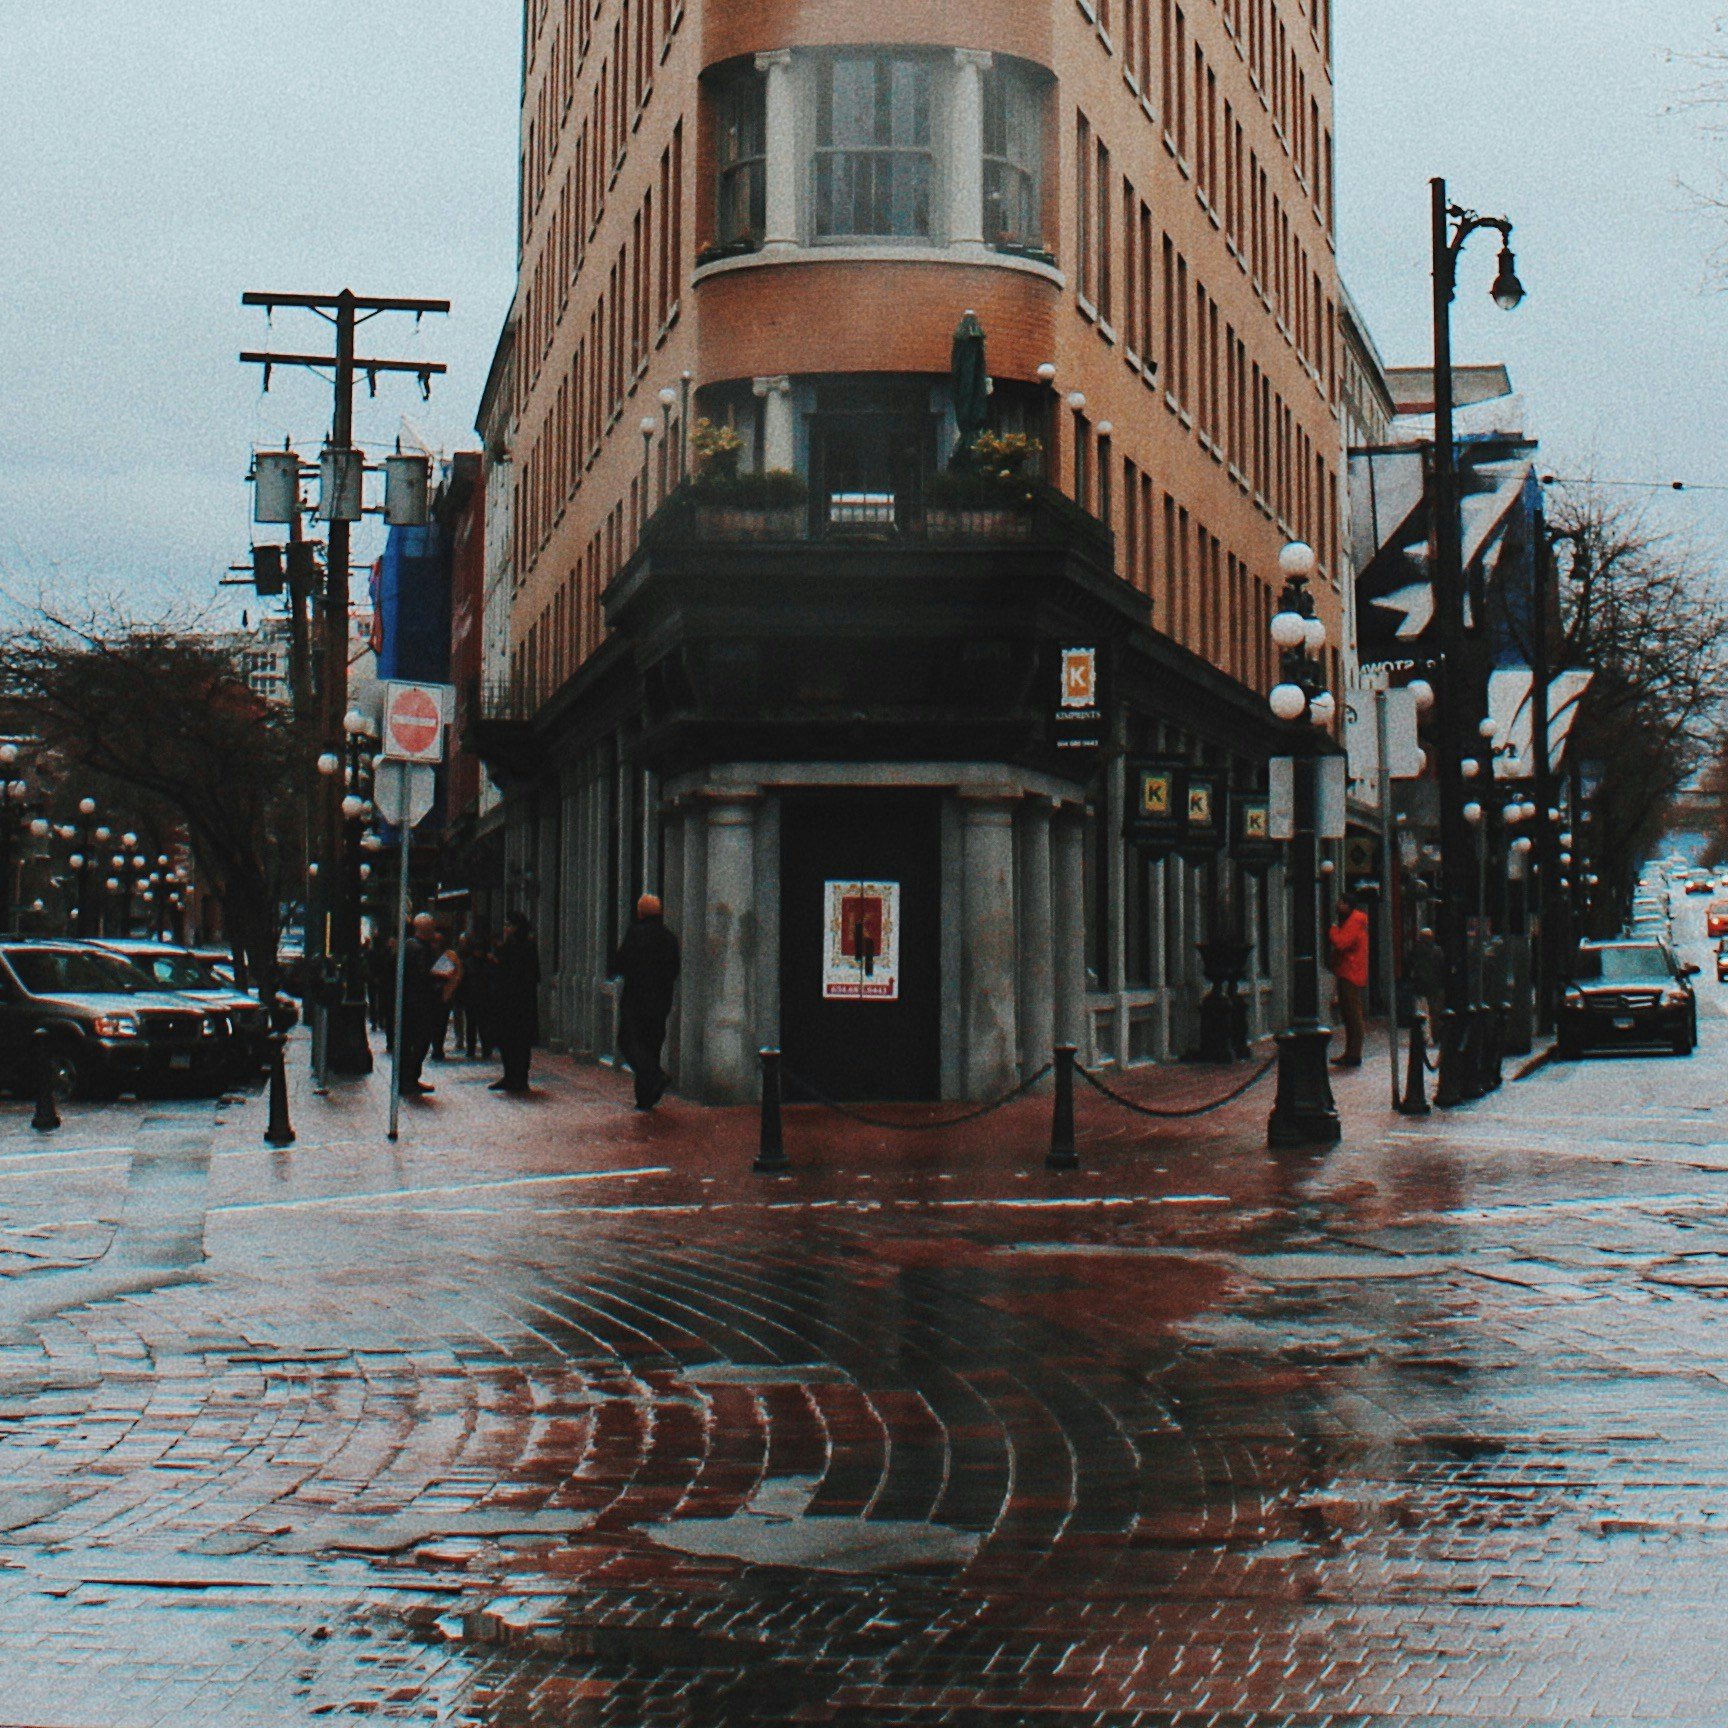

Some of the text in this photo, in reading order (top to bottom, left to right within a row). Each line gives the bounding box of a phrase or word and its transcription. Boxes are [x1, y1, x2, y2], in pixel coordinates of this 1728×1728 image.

[1069, 666, 1087, 688] K
[1147, 783, 1163, 804] K
[1190, 794, 1203, 813] K
[1249, 814, 1262, 830] K
